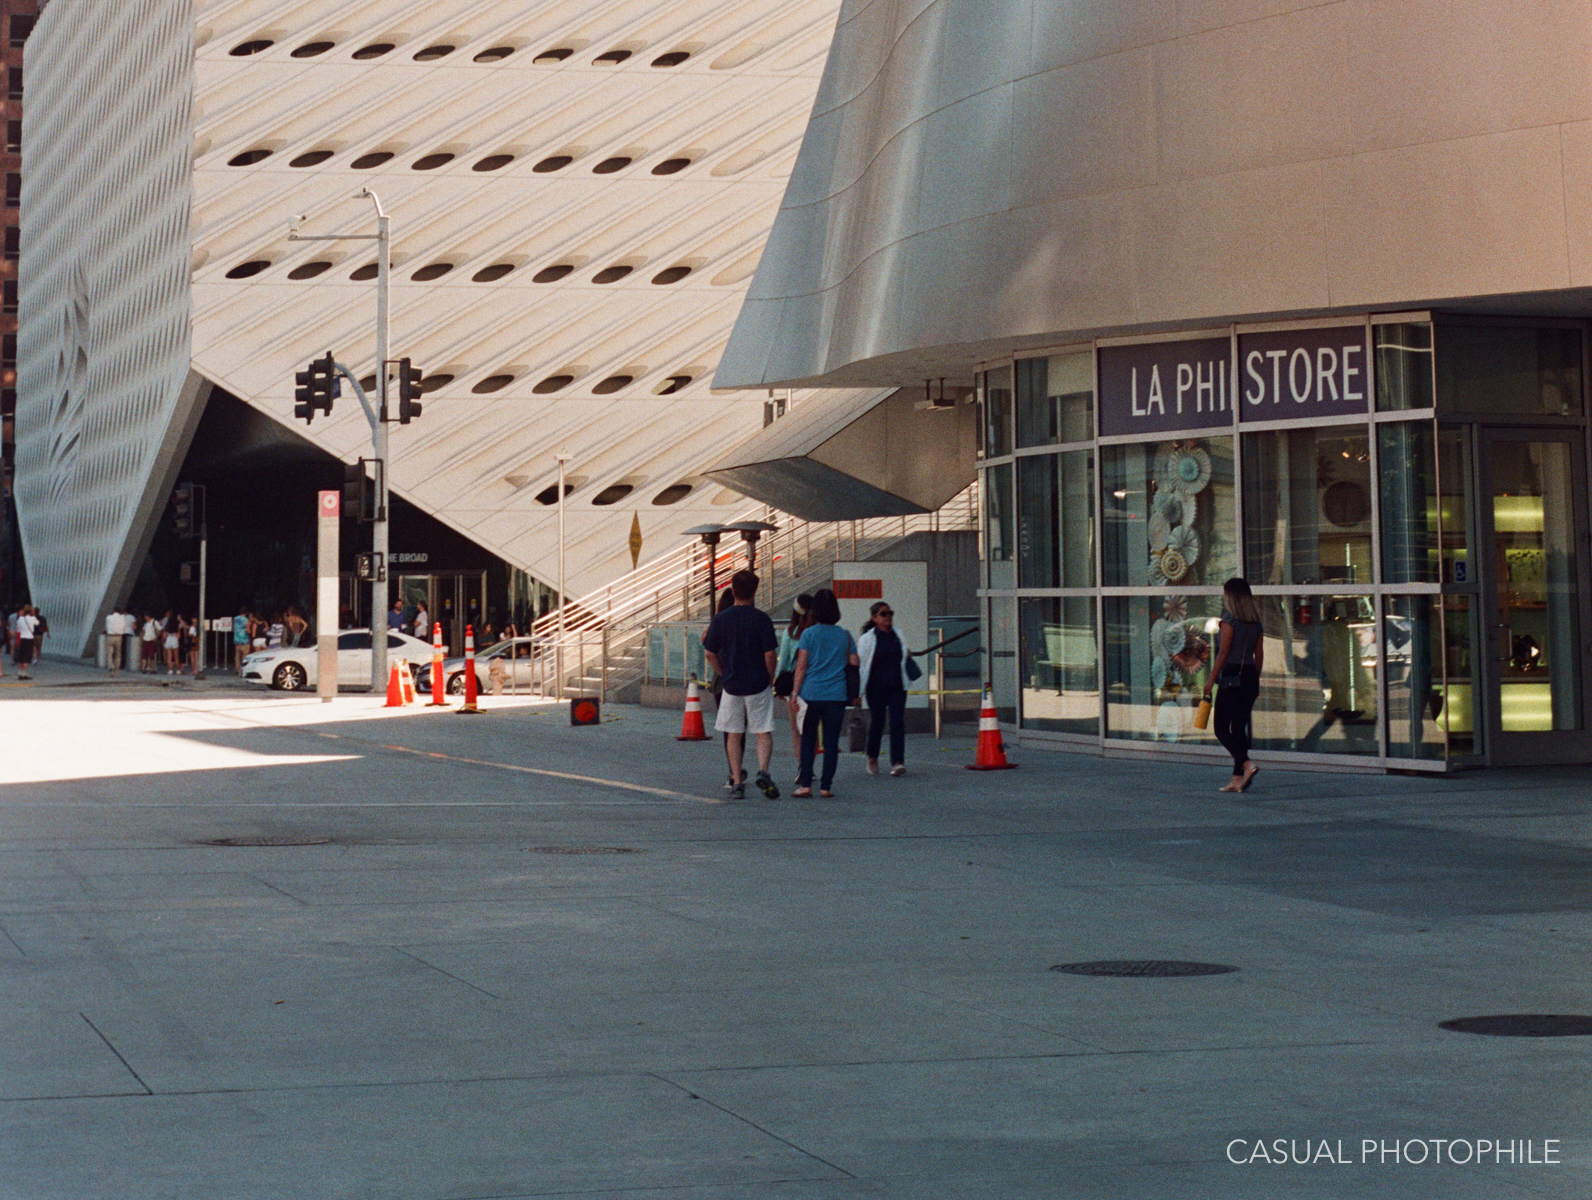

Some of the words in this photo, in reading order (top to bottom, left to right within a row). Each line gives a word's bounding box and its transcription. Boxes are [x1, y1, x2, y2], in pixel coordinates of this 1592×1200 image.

[1131, 363, 1165, 417] LA
[1176, 359, 1235, 415] PHI
[1245, 345, 1364, 406] STORE
[398, 552, 429, 563] BROAD
